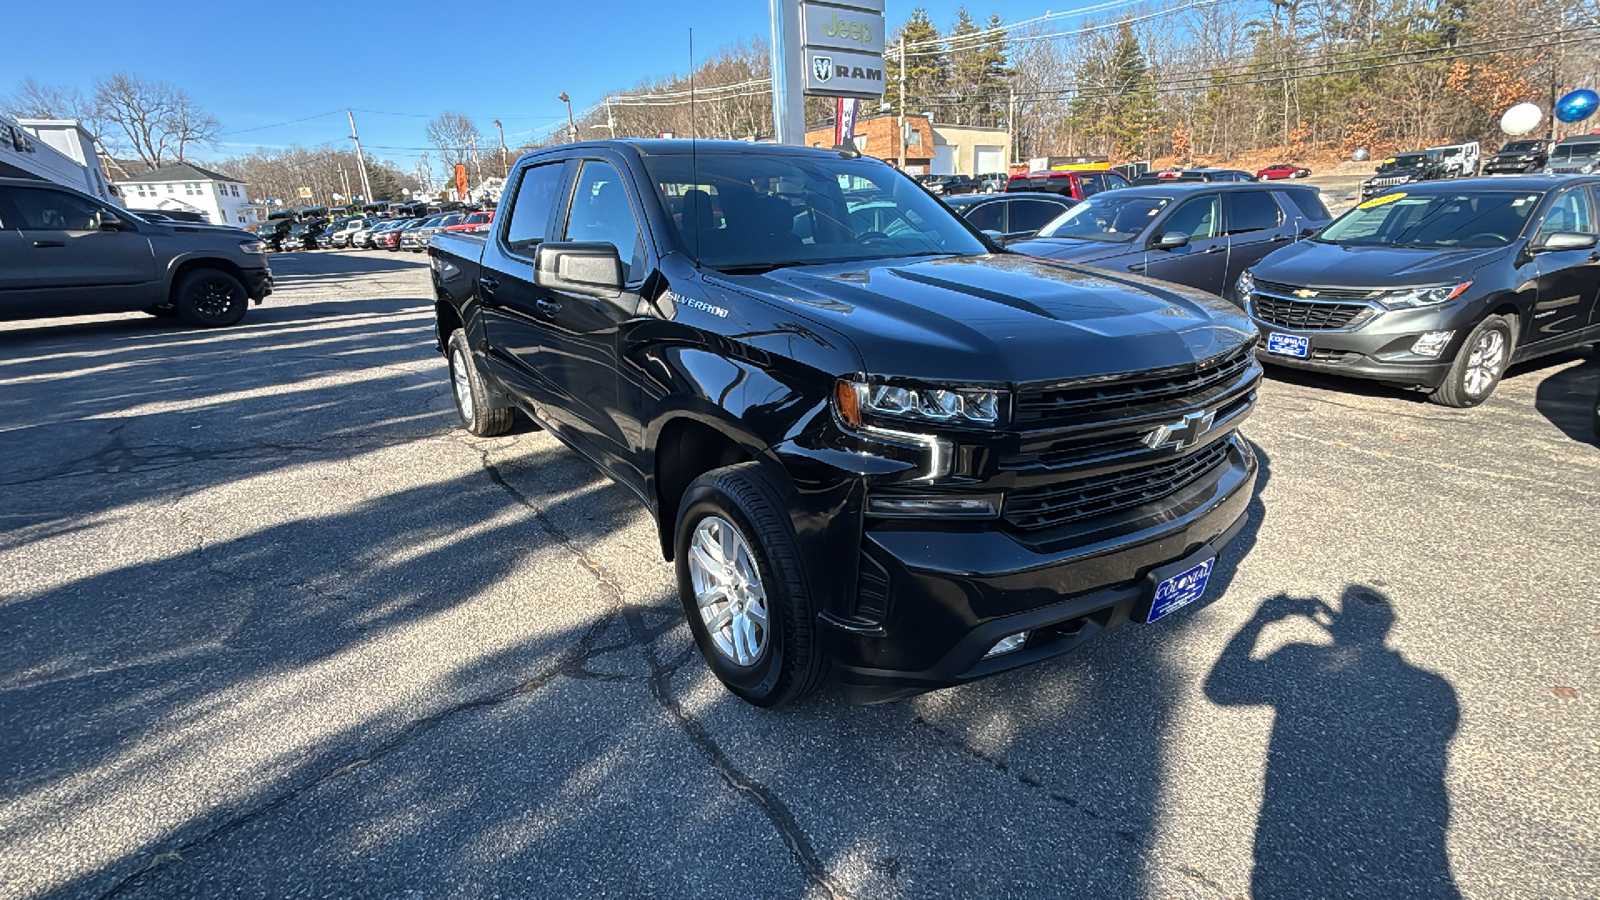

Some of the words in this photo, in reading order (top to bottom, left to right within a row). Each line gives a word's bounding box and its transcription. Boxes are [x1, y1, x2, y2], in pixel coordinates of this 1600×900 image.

[823, 12, 872, 46] Jeep
[835, 65, 882, 81] RAM
[667, 292, 730, 318] SILVERADO
